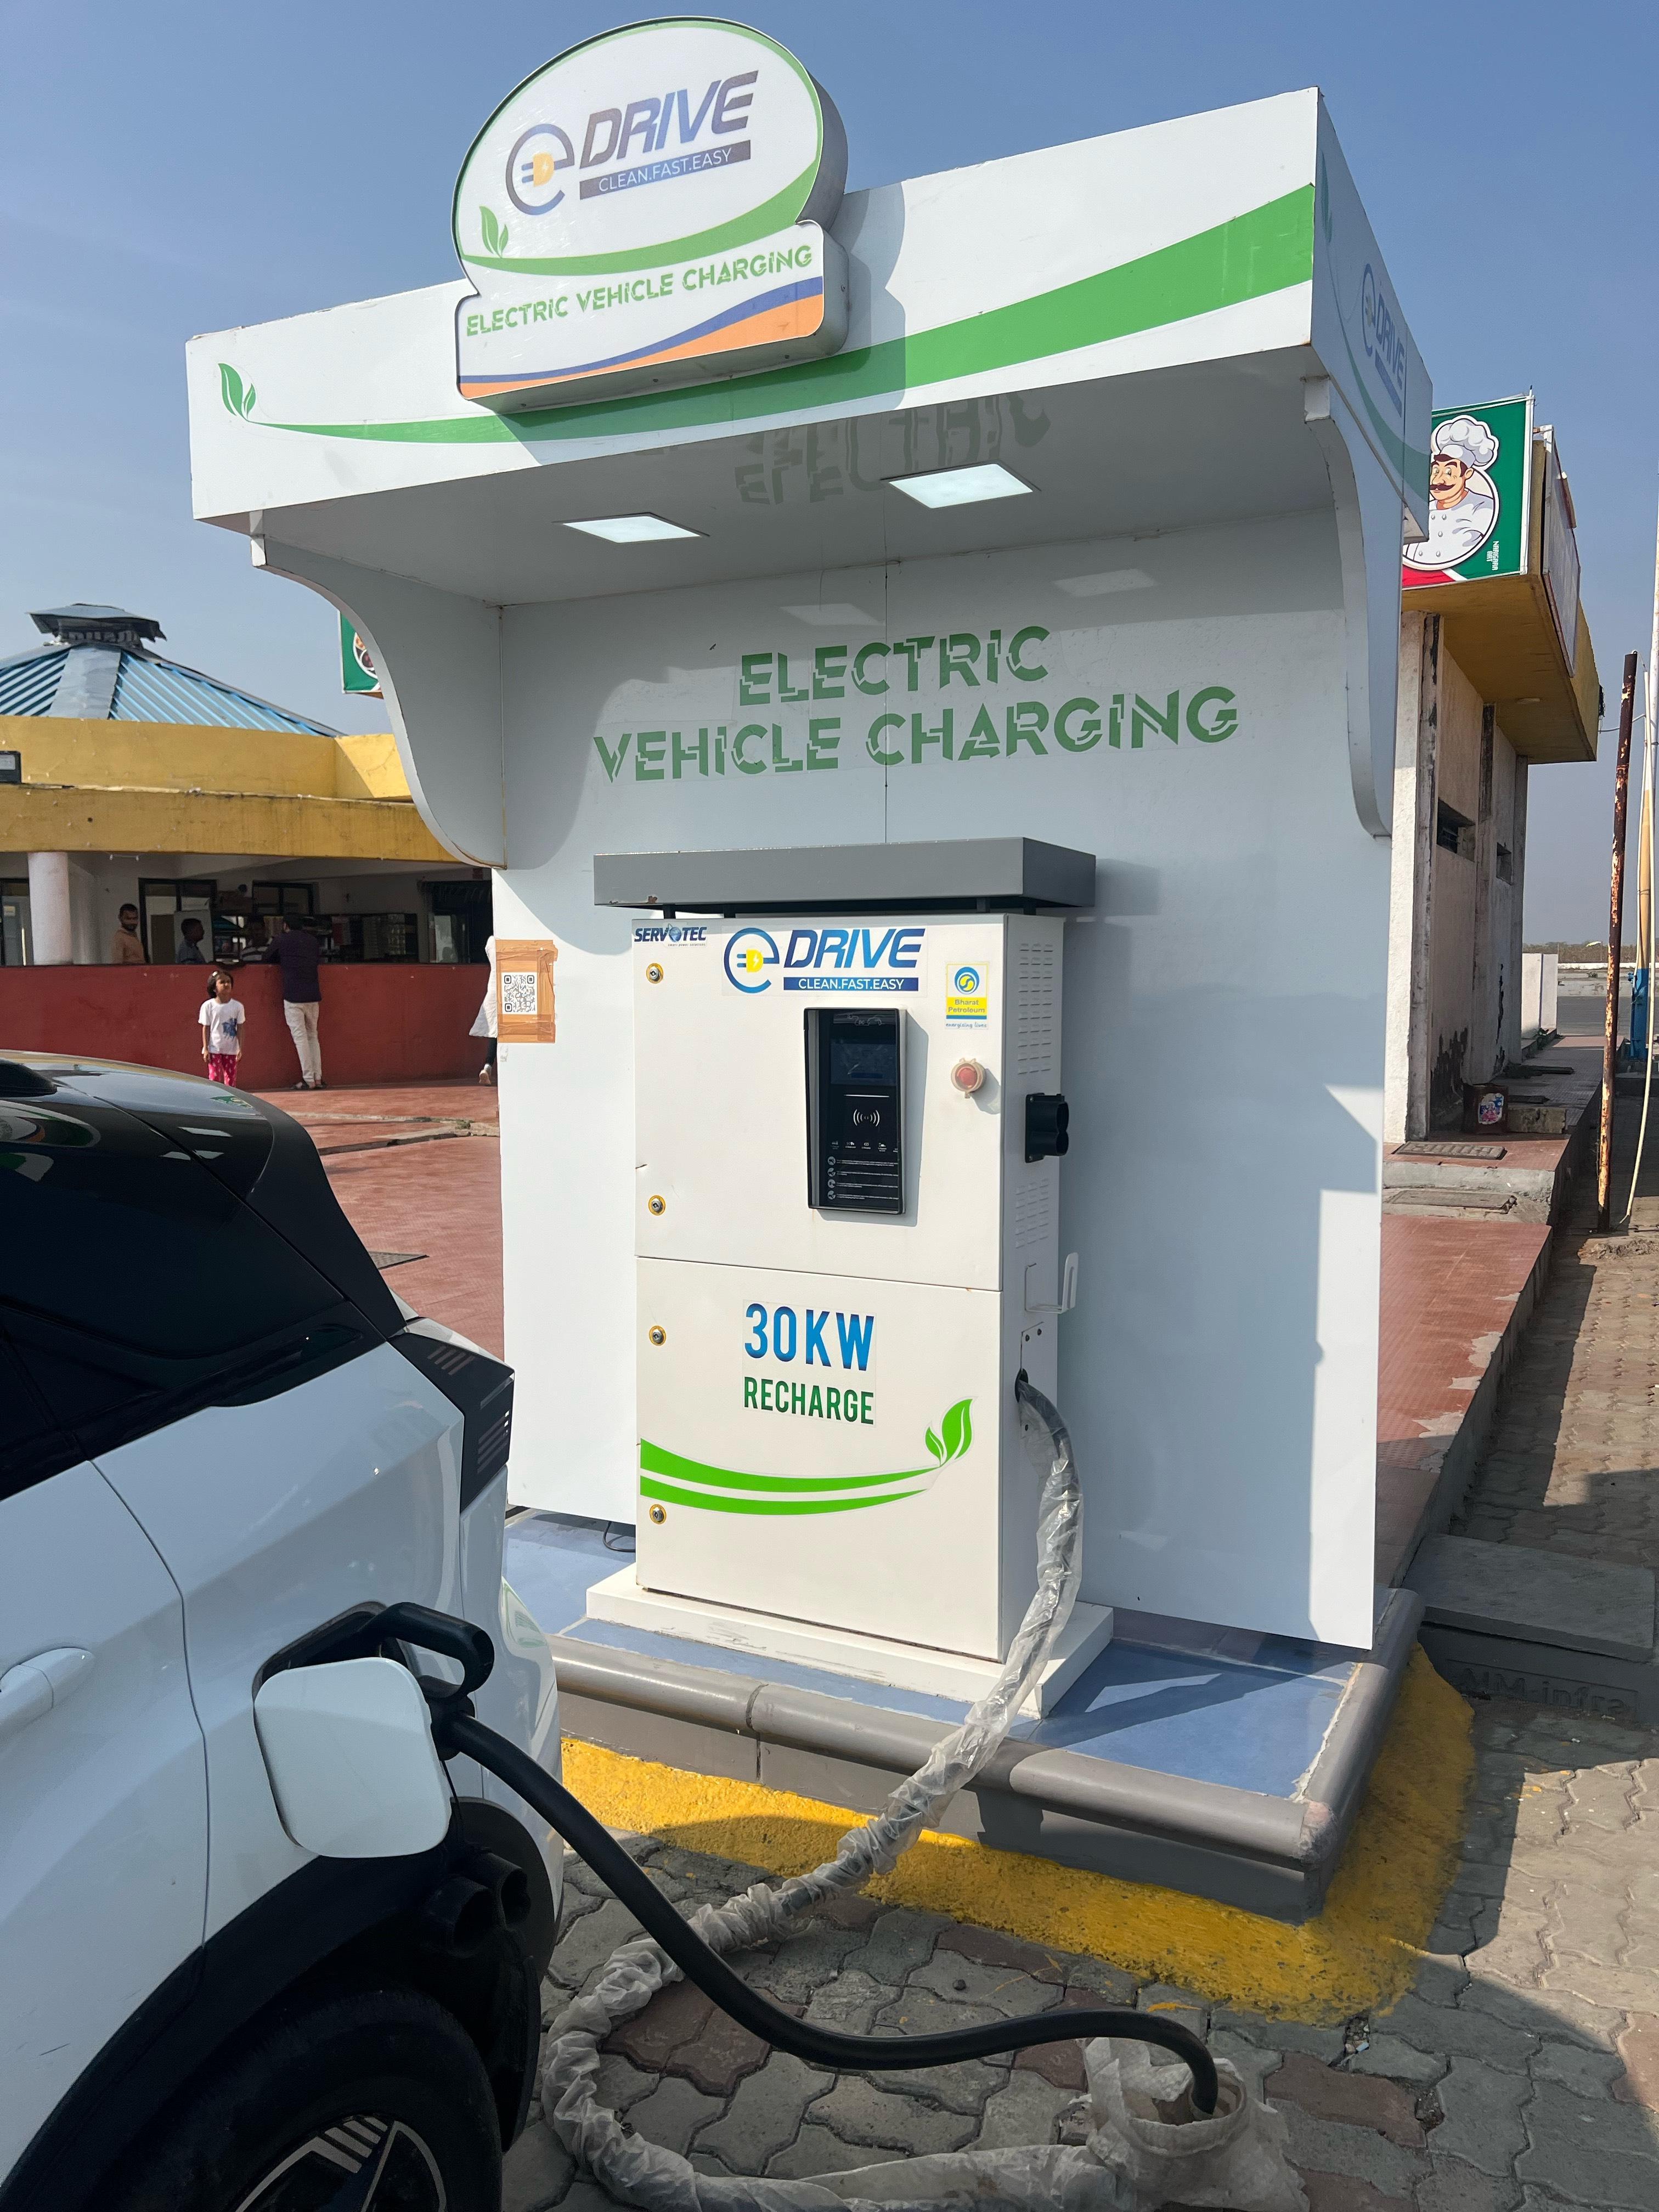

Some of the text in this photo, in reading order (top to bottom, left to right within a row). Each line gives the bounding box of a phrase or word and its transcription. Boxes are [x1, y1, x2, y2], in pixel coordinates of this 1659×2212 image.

[599, 147, 732, 194] CLEAN.FAST.EASY
[466, 245, 813, 337] ELECTRIC VEHICLE CHARGING
[739, 625, 1051, 707] ELECTRIC
[592, 685, 1240, 783] VEHICLE CHARGING
[798, 978, 905, 990] CLEAN.FAST.EASY
[744, 1376, 874, 1425] RECHARGE
